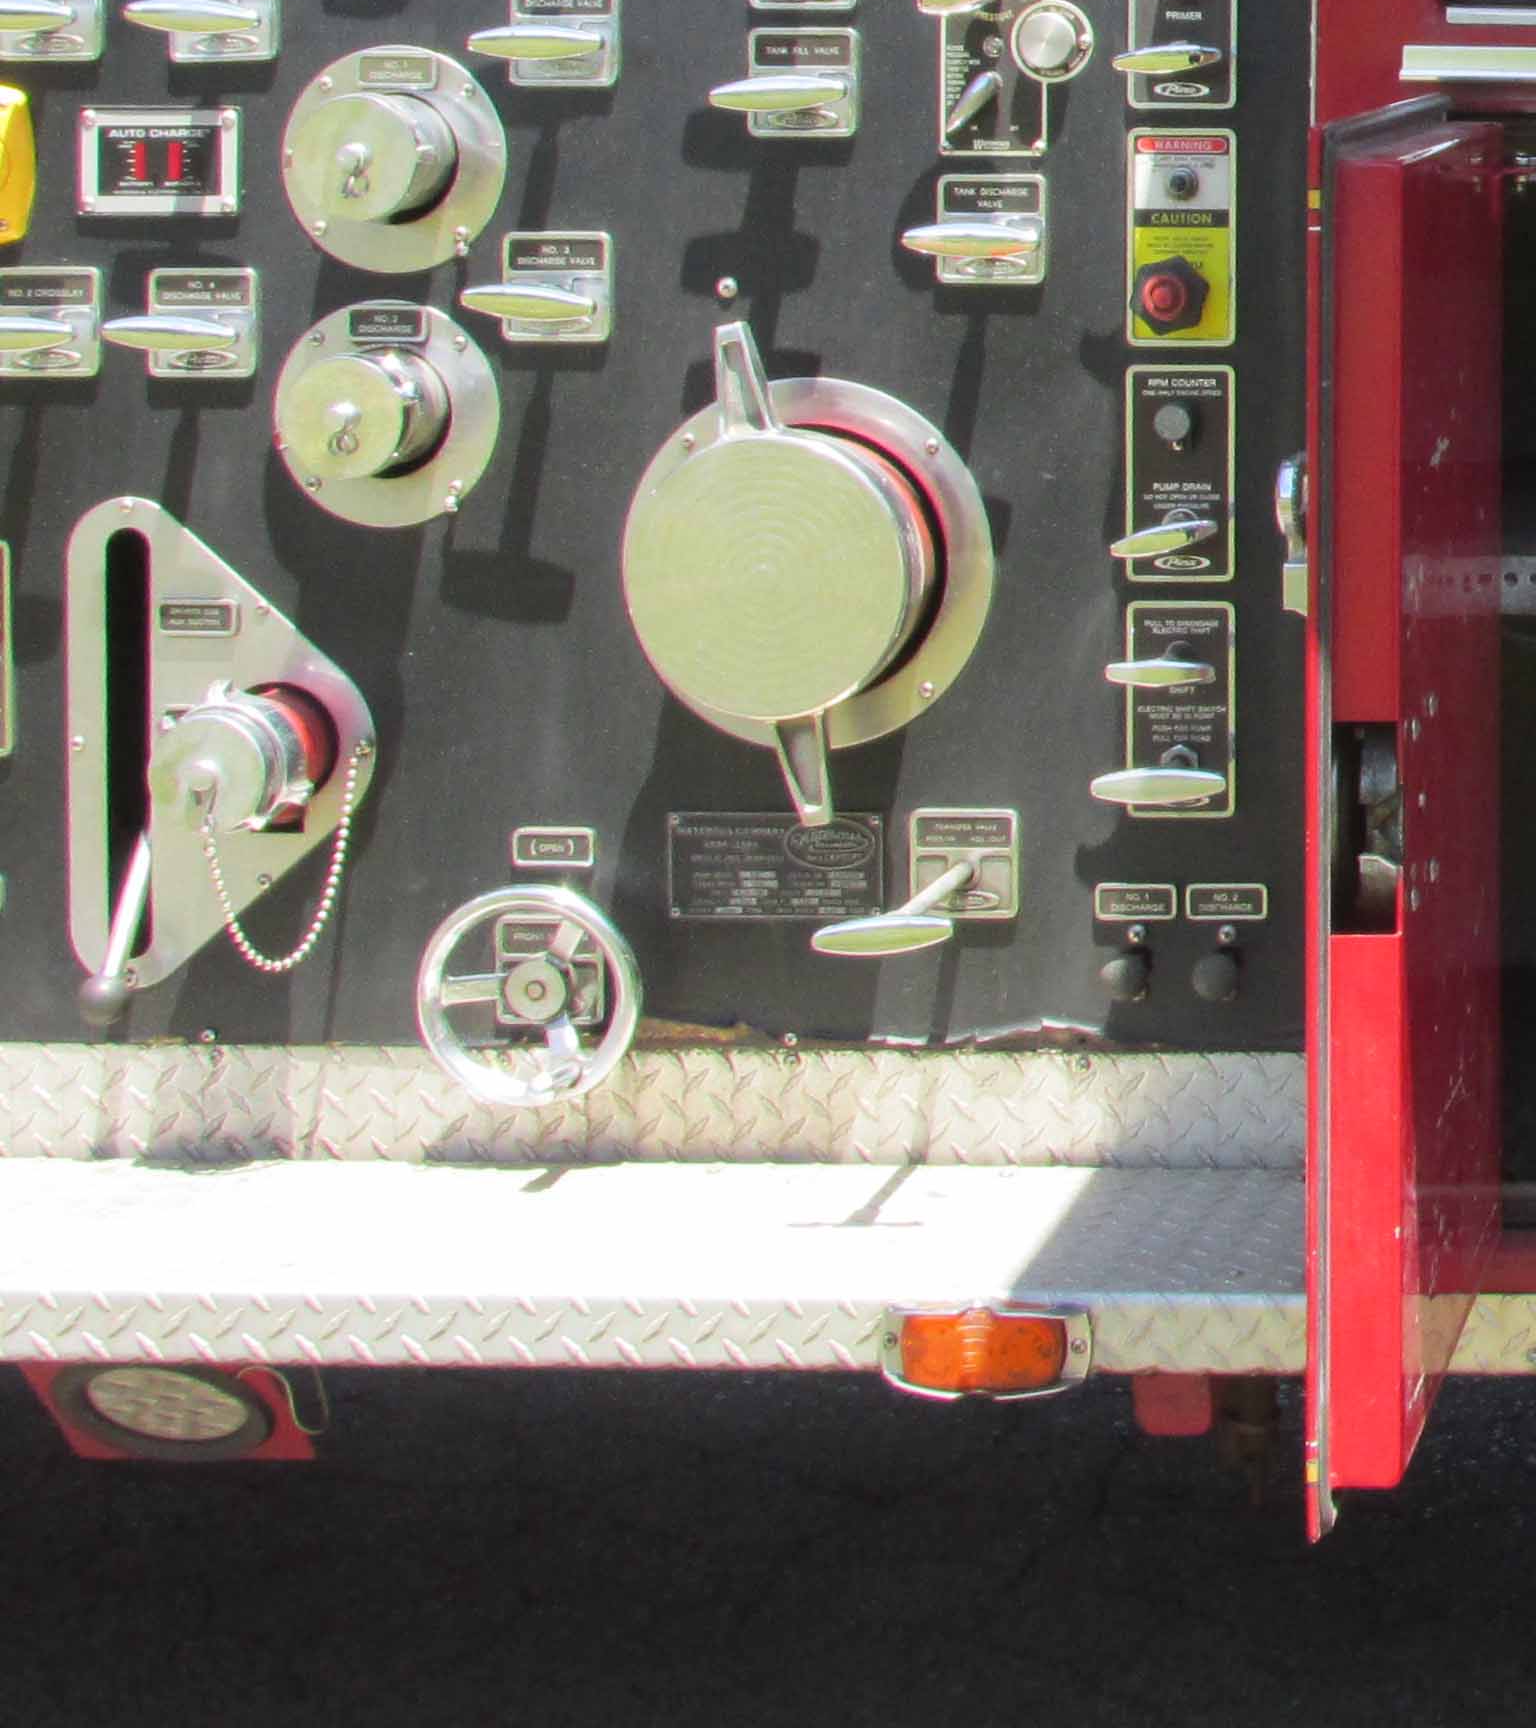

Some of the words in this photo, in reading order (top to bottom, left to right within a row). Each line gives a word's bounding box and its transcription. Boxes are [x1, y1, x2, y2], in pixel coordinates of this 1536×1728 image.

[525, 0, 574, 8] DISCHARGE
[577, 0, 603, 8] VALVE
[1166, 11, 1202, 20] PRIMER
[766, 46, 788, 55] TANK
[793, 46, 810, 55] FILL
[814, 46, 840, 55] VALVE
[109, 129, 146, 138] AUTO
[1154, 139, 1210, 150] WARNING
[954, 187, 976, 196] TANK
[979, 187, 1029, 196] DISCHARGE
[977, 199, 1003, 209] VALVE
[1151, 213, 1212, 225] CAUTION
[518, 257, 566, 265] DISCHARGE
[570, 257, 596, 265] VALVE
[35, 289, 83, 297] CROSSLAY
[162, 292, 212, 300] DISCHARGE
[216, 292, 241, 300] VALVE
[358, 325, 412, 333] DISCHARGE
[1148, 379, 1169, 387] RPM
[1172, 379, 1216, 387] COUNTER
[1111, 903, 1165, 912] DISCHARGE
[1199, 903, 1252, 912] DISCHARGE
